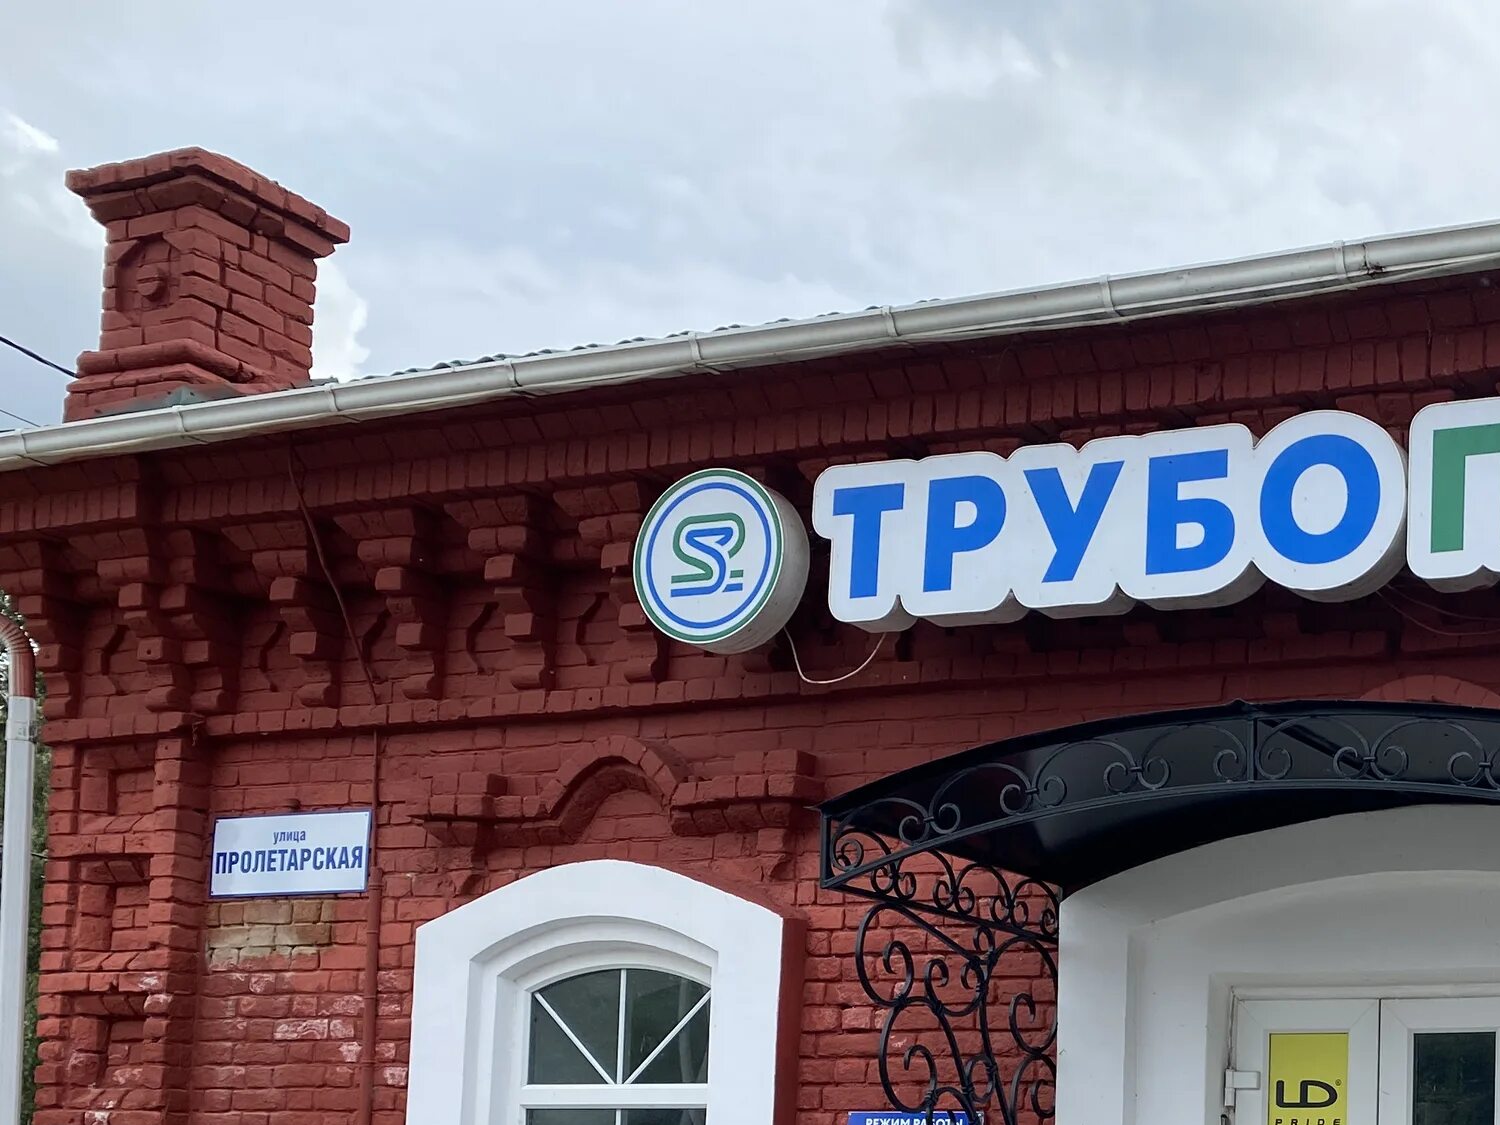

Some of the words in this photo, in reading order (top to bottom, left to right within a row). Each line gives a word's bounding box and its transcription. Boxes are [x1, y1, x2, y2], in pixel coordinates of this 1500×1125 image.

[273, 829, 306, 845] улица
[215, 845, 363, 875] ПРОЛЕТАРСКАЯ
[1276, 1079, 1338, 1108] LD
